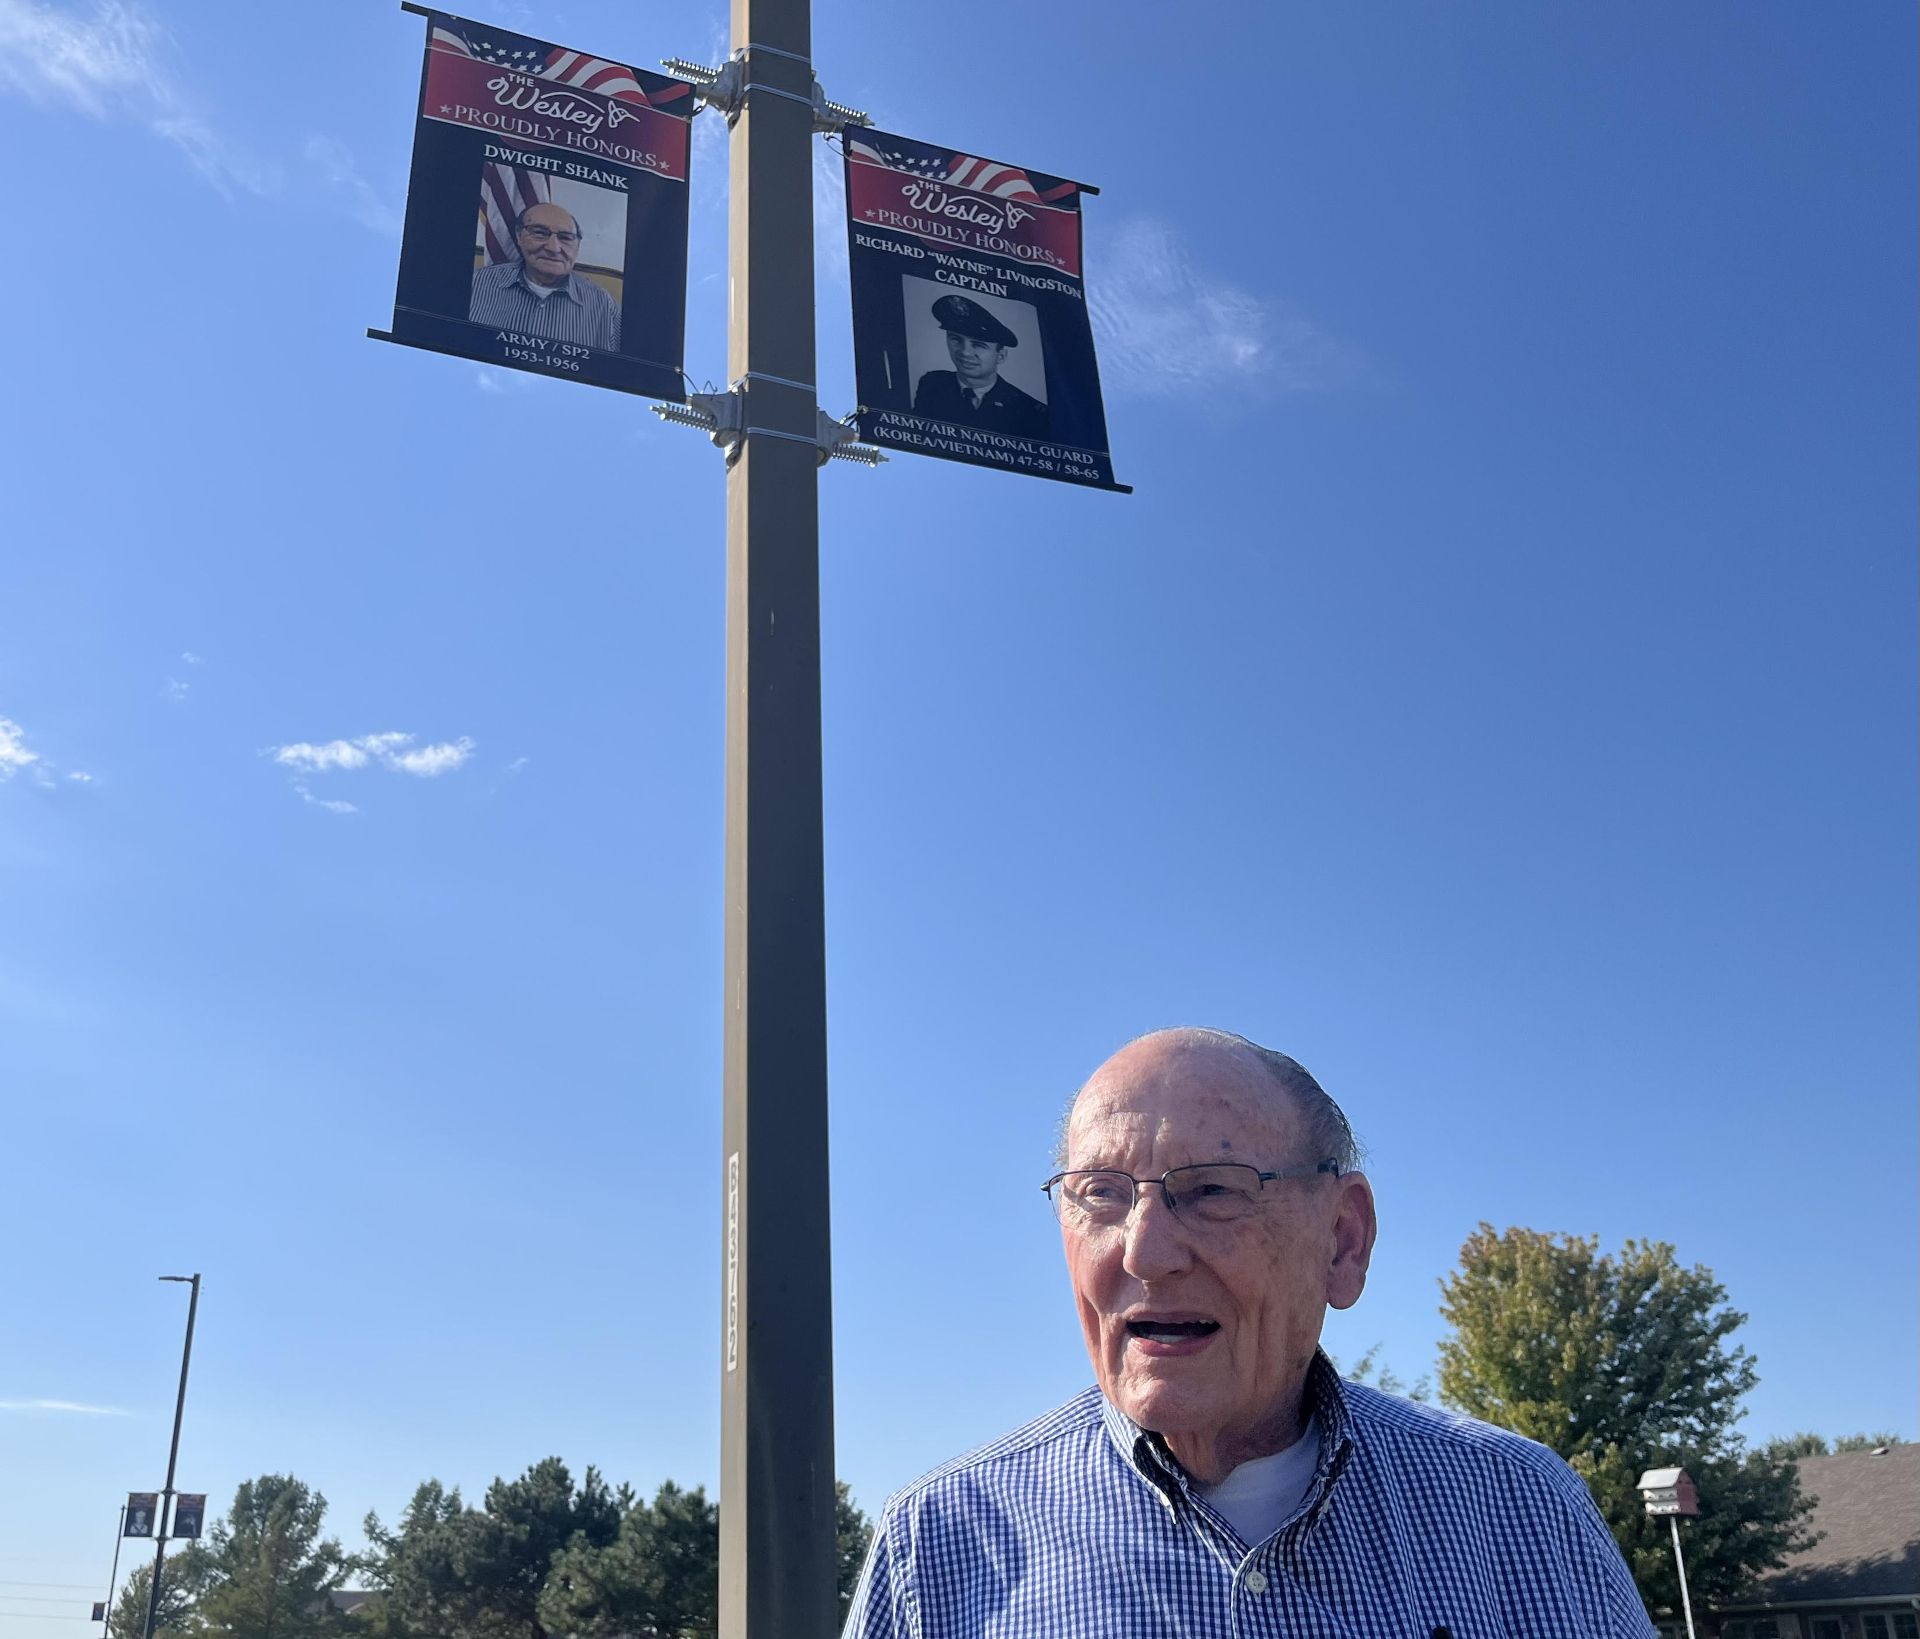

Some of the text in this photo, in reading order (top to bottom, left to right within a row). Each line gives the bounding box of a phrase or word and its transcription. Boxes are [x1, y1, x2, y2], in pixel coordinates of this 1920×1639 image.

[487, 77, 605, 133] Wesley
[508, 73, 534, 88] THE
[454, 105, 657, 168] PROUDLY HONORS
[484, 144, 629, 190] DWIGHT SHANK
[918, 181, 942, 194] THE
[902, 183, 1005, 234] Wesley
[878, 209, 1055, 263] PROUDLY HONORS
[855, 233, 924, 259] RICHARD
[996, 268, 1082, 300] LIVINGSTON
[935, 269, 1008, 297] CAPTAIN
[496, 331, 549, 351] ARMY
[561, 343, 591, 359] SP2
[504, 347, 580, 372] 1953-1956
[873, 426, 1015, 465] (KOREA/VIETNAM)
[1017, 456, 1053, 471] 47-58
[1064, 464, 1099, 480] 58-65
[879, 412, 1094, 465] ARMY/AIR NATIONAL GUARD
